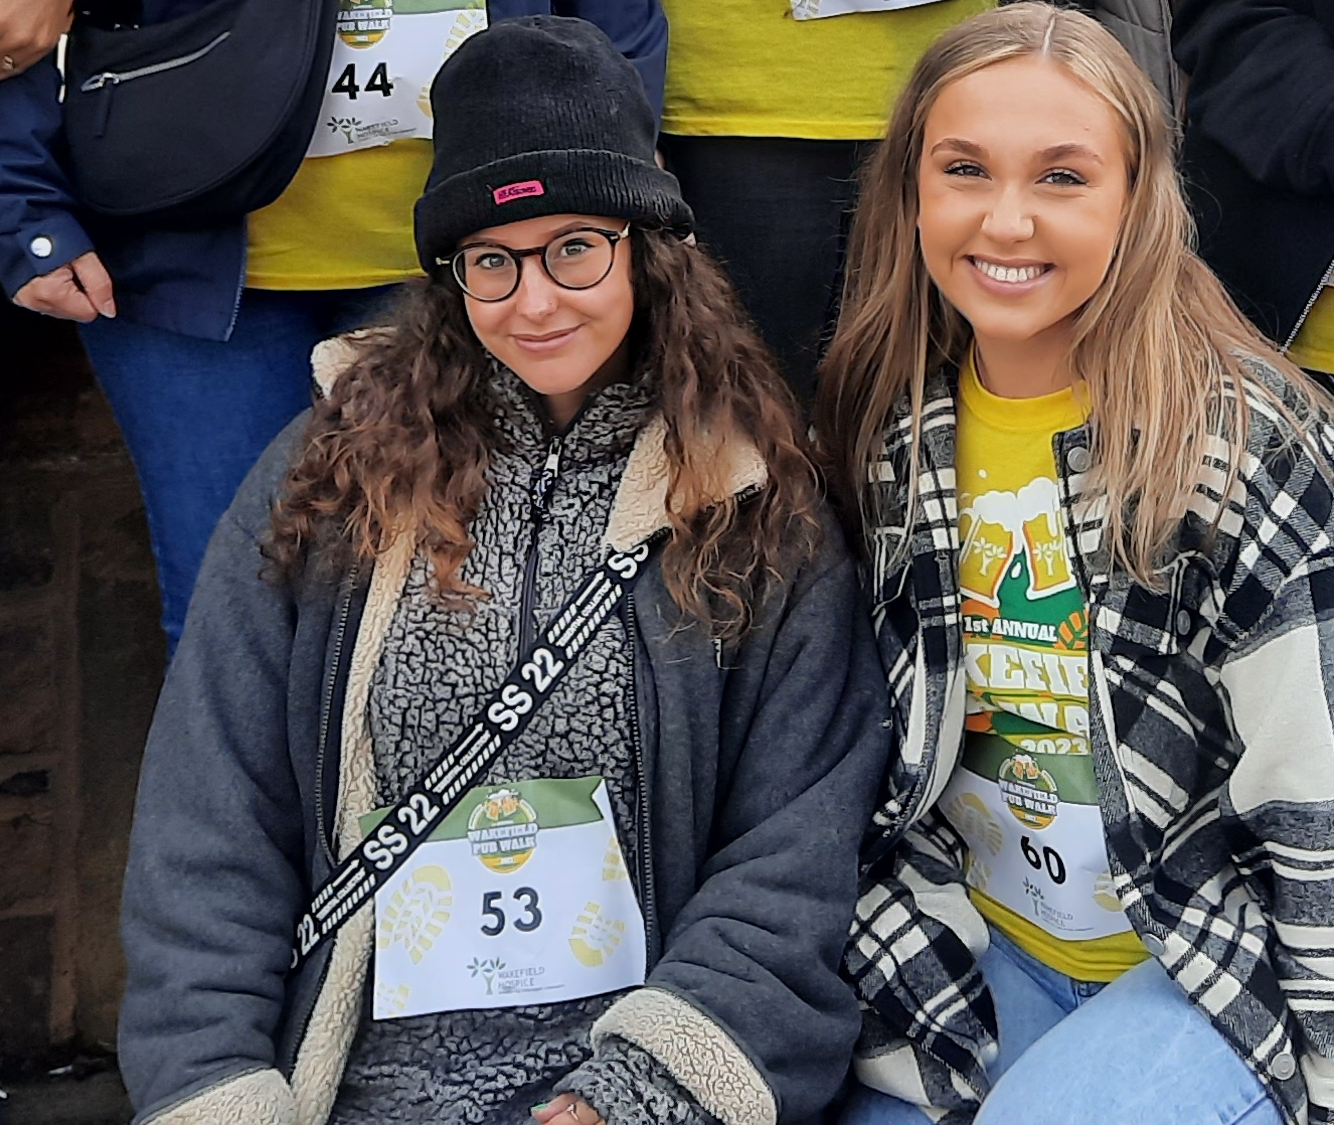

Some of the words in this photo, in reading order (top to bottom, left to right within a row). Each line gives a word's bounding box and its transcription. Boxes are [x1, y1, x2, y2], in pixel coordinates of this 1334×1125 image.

[332, 62, 394, 100] 44
[964, 616, 990, 634] 1st
[992, 618, 1058, 642] ANNUAL
[363, 825, 408, 870] SS
[397, 793, 441, 836] 22
[487, 683, 533, 731] SS
[521, 647, 565, 693] 22
[499, 835, 536, 852] WALK
[1020, 834, 1067, 886] 60
[480, 885, 543, 937] 53
[498, 966, 545, 979] WAKEFIELD
[498, 977, 535, 990] HOSPICE
